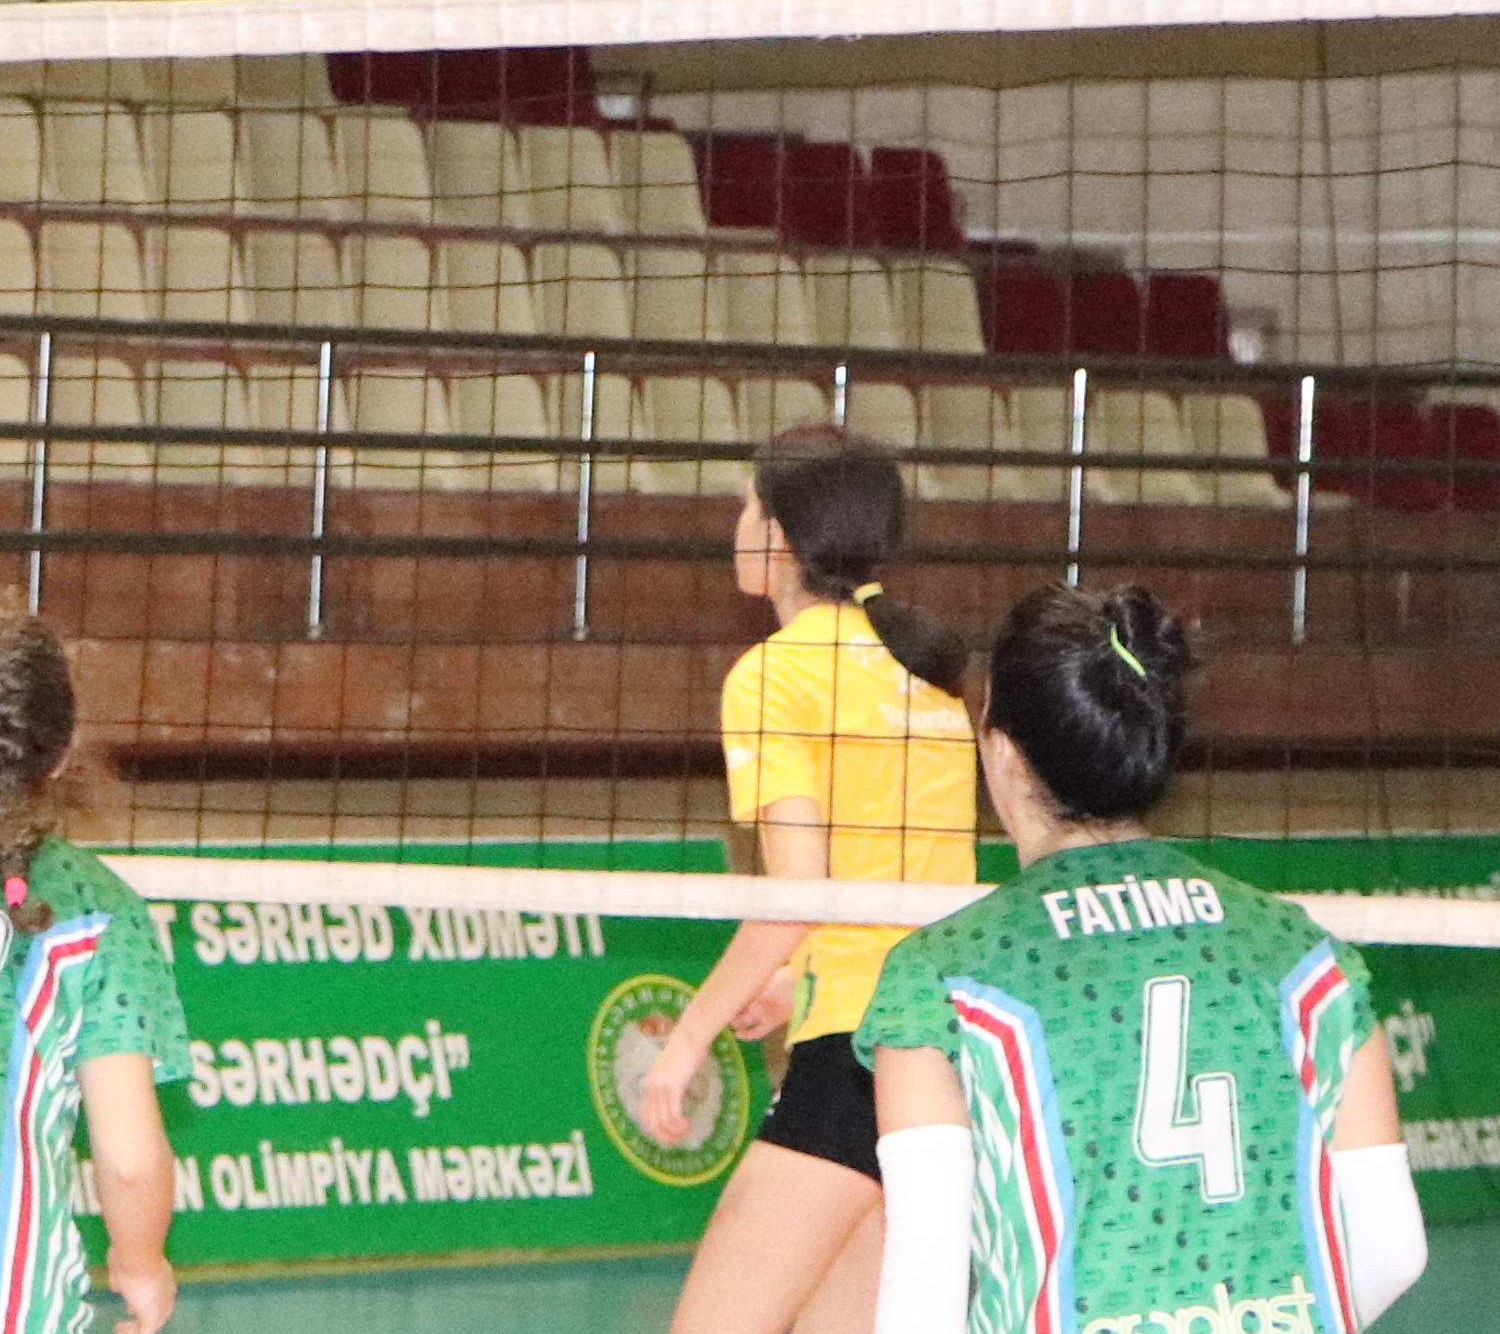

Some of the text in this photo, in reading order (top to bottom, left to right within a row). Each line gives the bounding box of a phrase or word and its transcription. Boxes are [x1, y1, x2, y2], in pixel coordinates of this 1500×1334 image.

[1042, 875, 1225, 940] FATİMƏ
[1132, 975, 1244, 1204] 4
[210, 1136, 407, 1210] OLİMPİYA
[408, 1129, 594, 1204] MƏRKƏZİ
